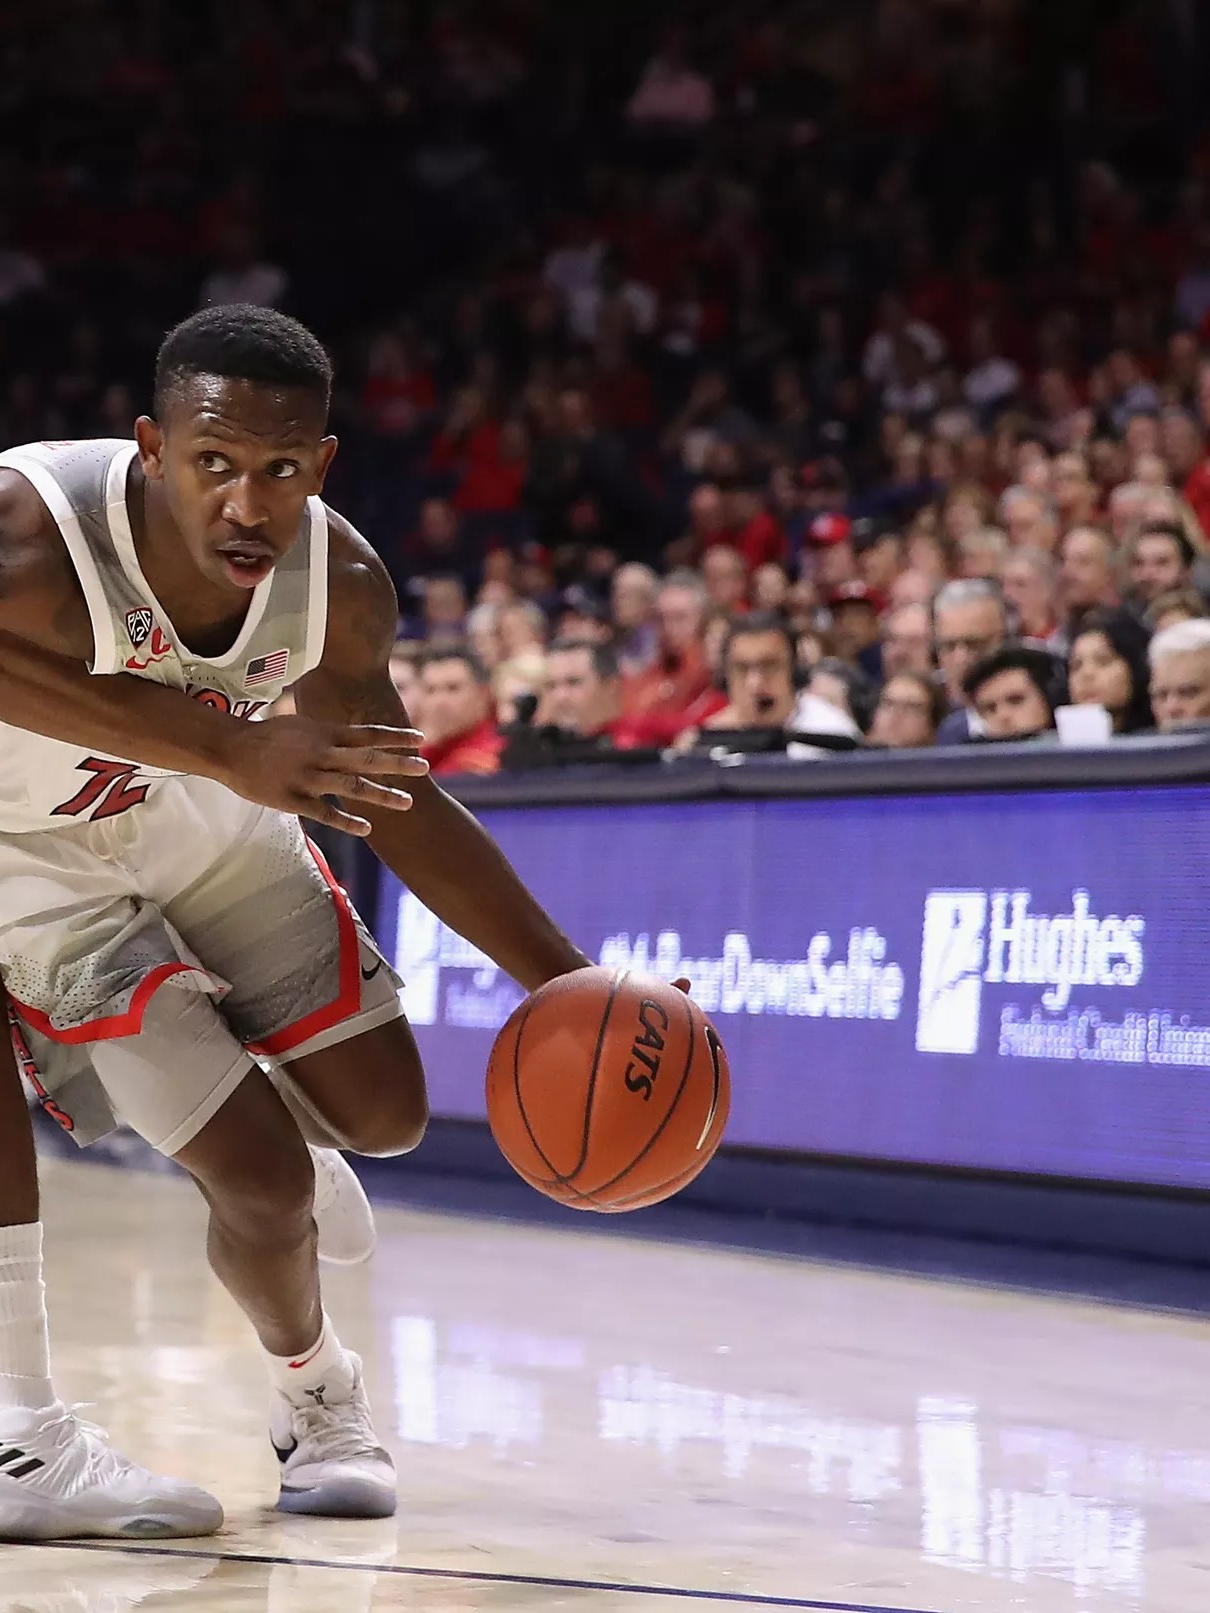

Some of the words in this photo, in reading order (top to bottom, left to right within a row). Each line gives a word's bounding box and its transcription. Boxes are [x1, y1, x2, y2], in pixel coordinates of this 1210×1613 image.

[127, 610, 151, 636] PAC
[983, 888, 1146, 1015] Hughes
[625, 999, 668, 1102] CATS
